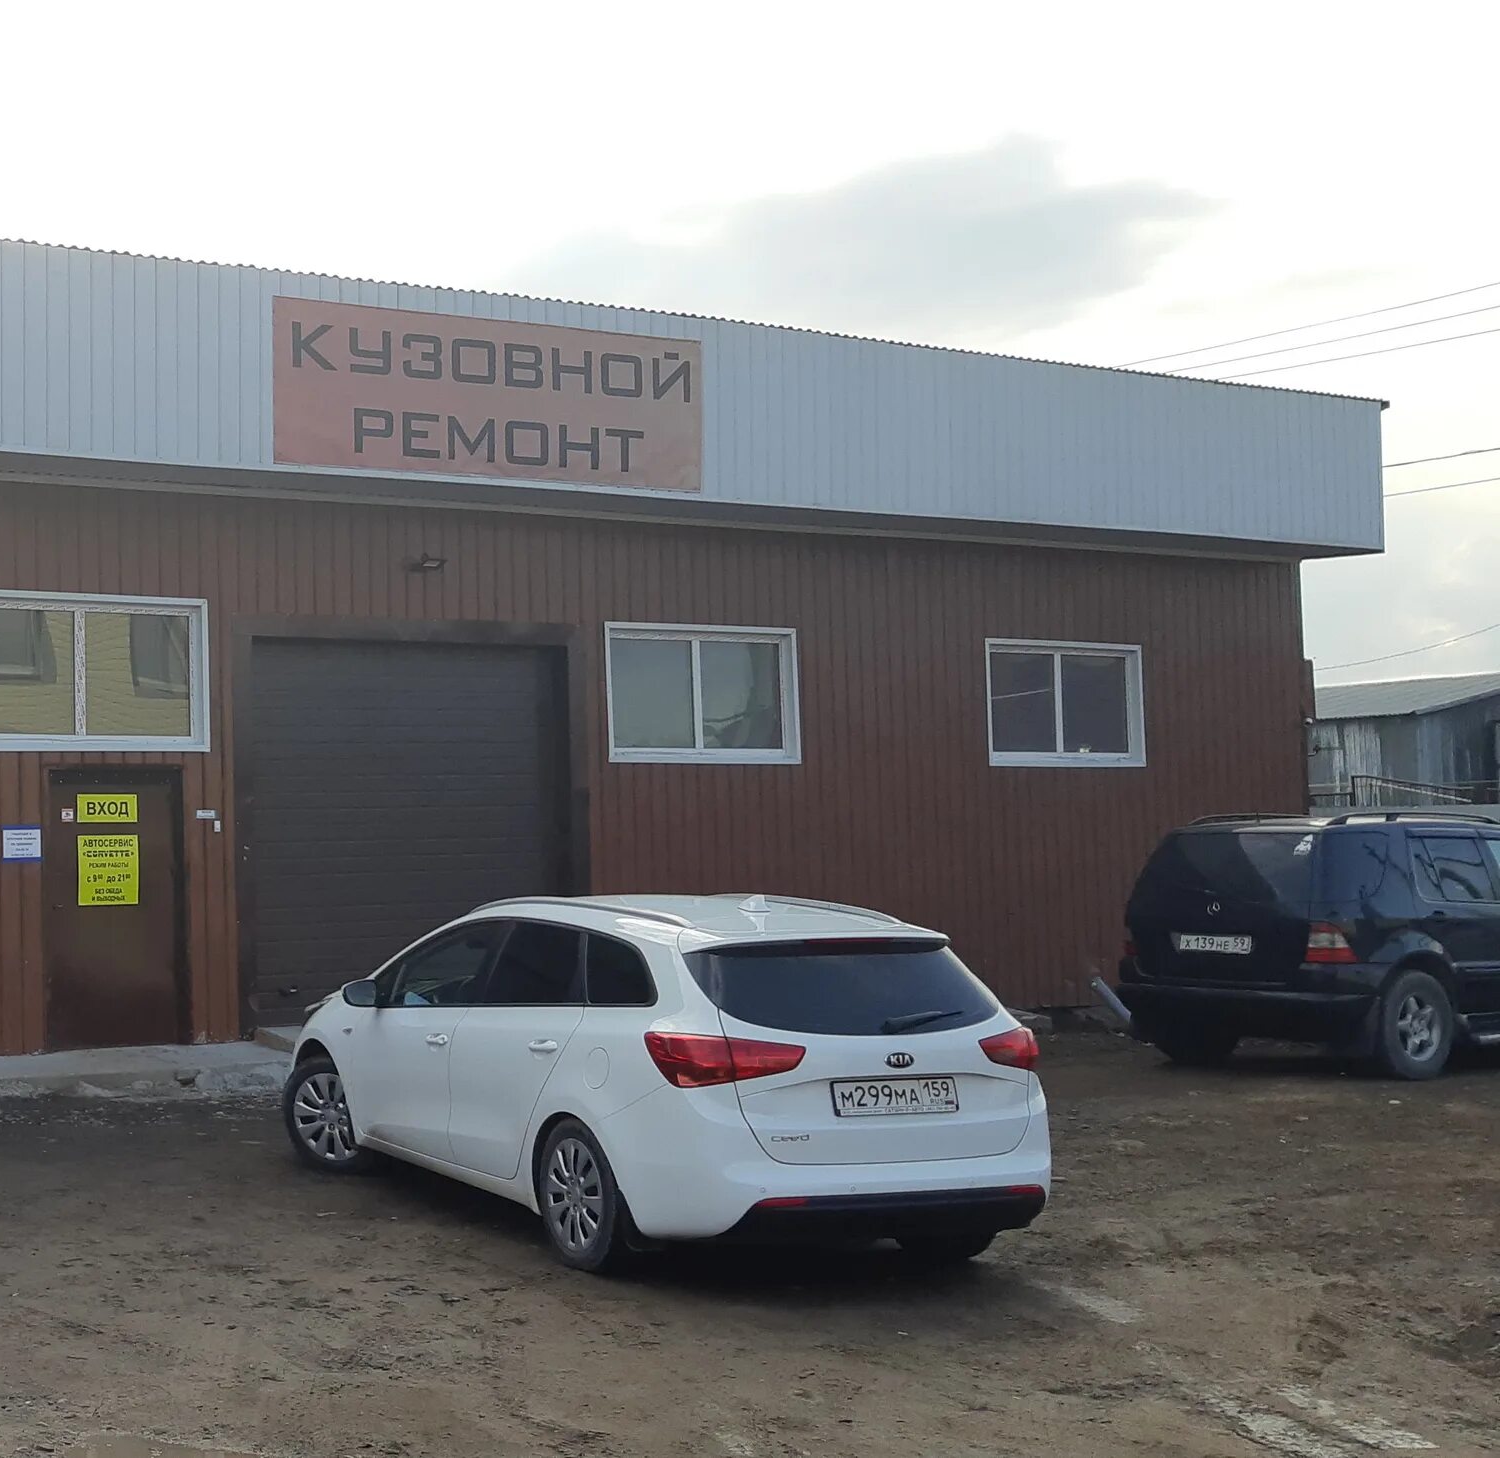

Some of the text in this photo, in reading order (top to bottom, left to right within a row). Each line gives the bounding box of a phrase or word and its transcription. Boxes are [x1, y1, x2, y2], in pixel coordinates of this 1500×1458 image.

[291, 320, 691, 403] КУЗОВНОЙ
[353, 407, 645, 473] РЕМОНТ
[86, 801, 129, 818] ВХОД
[83, 838, 134, 848] АВТОСЕРВИС
[1233, 937, 1246, 948] 59
[889, 1054, 912, 1066] KIA
[922, 1081, 950, 1098] 159
